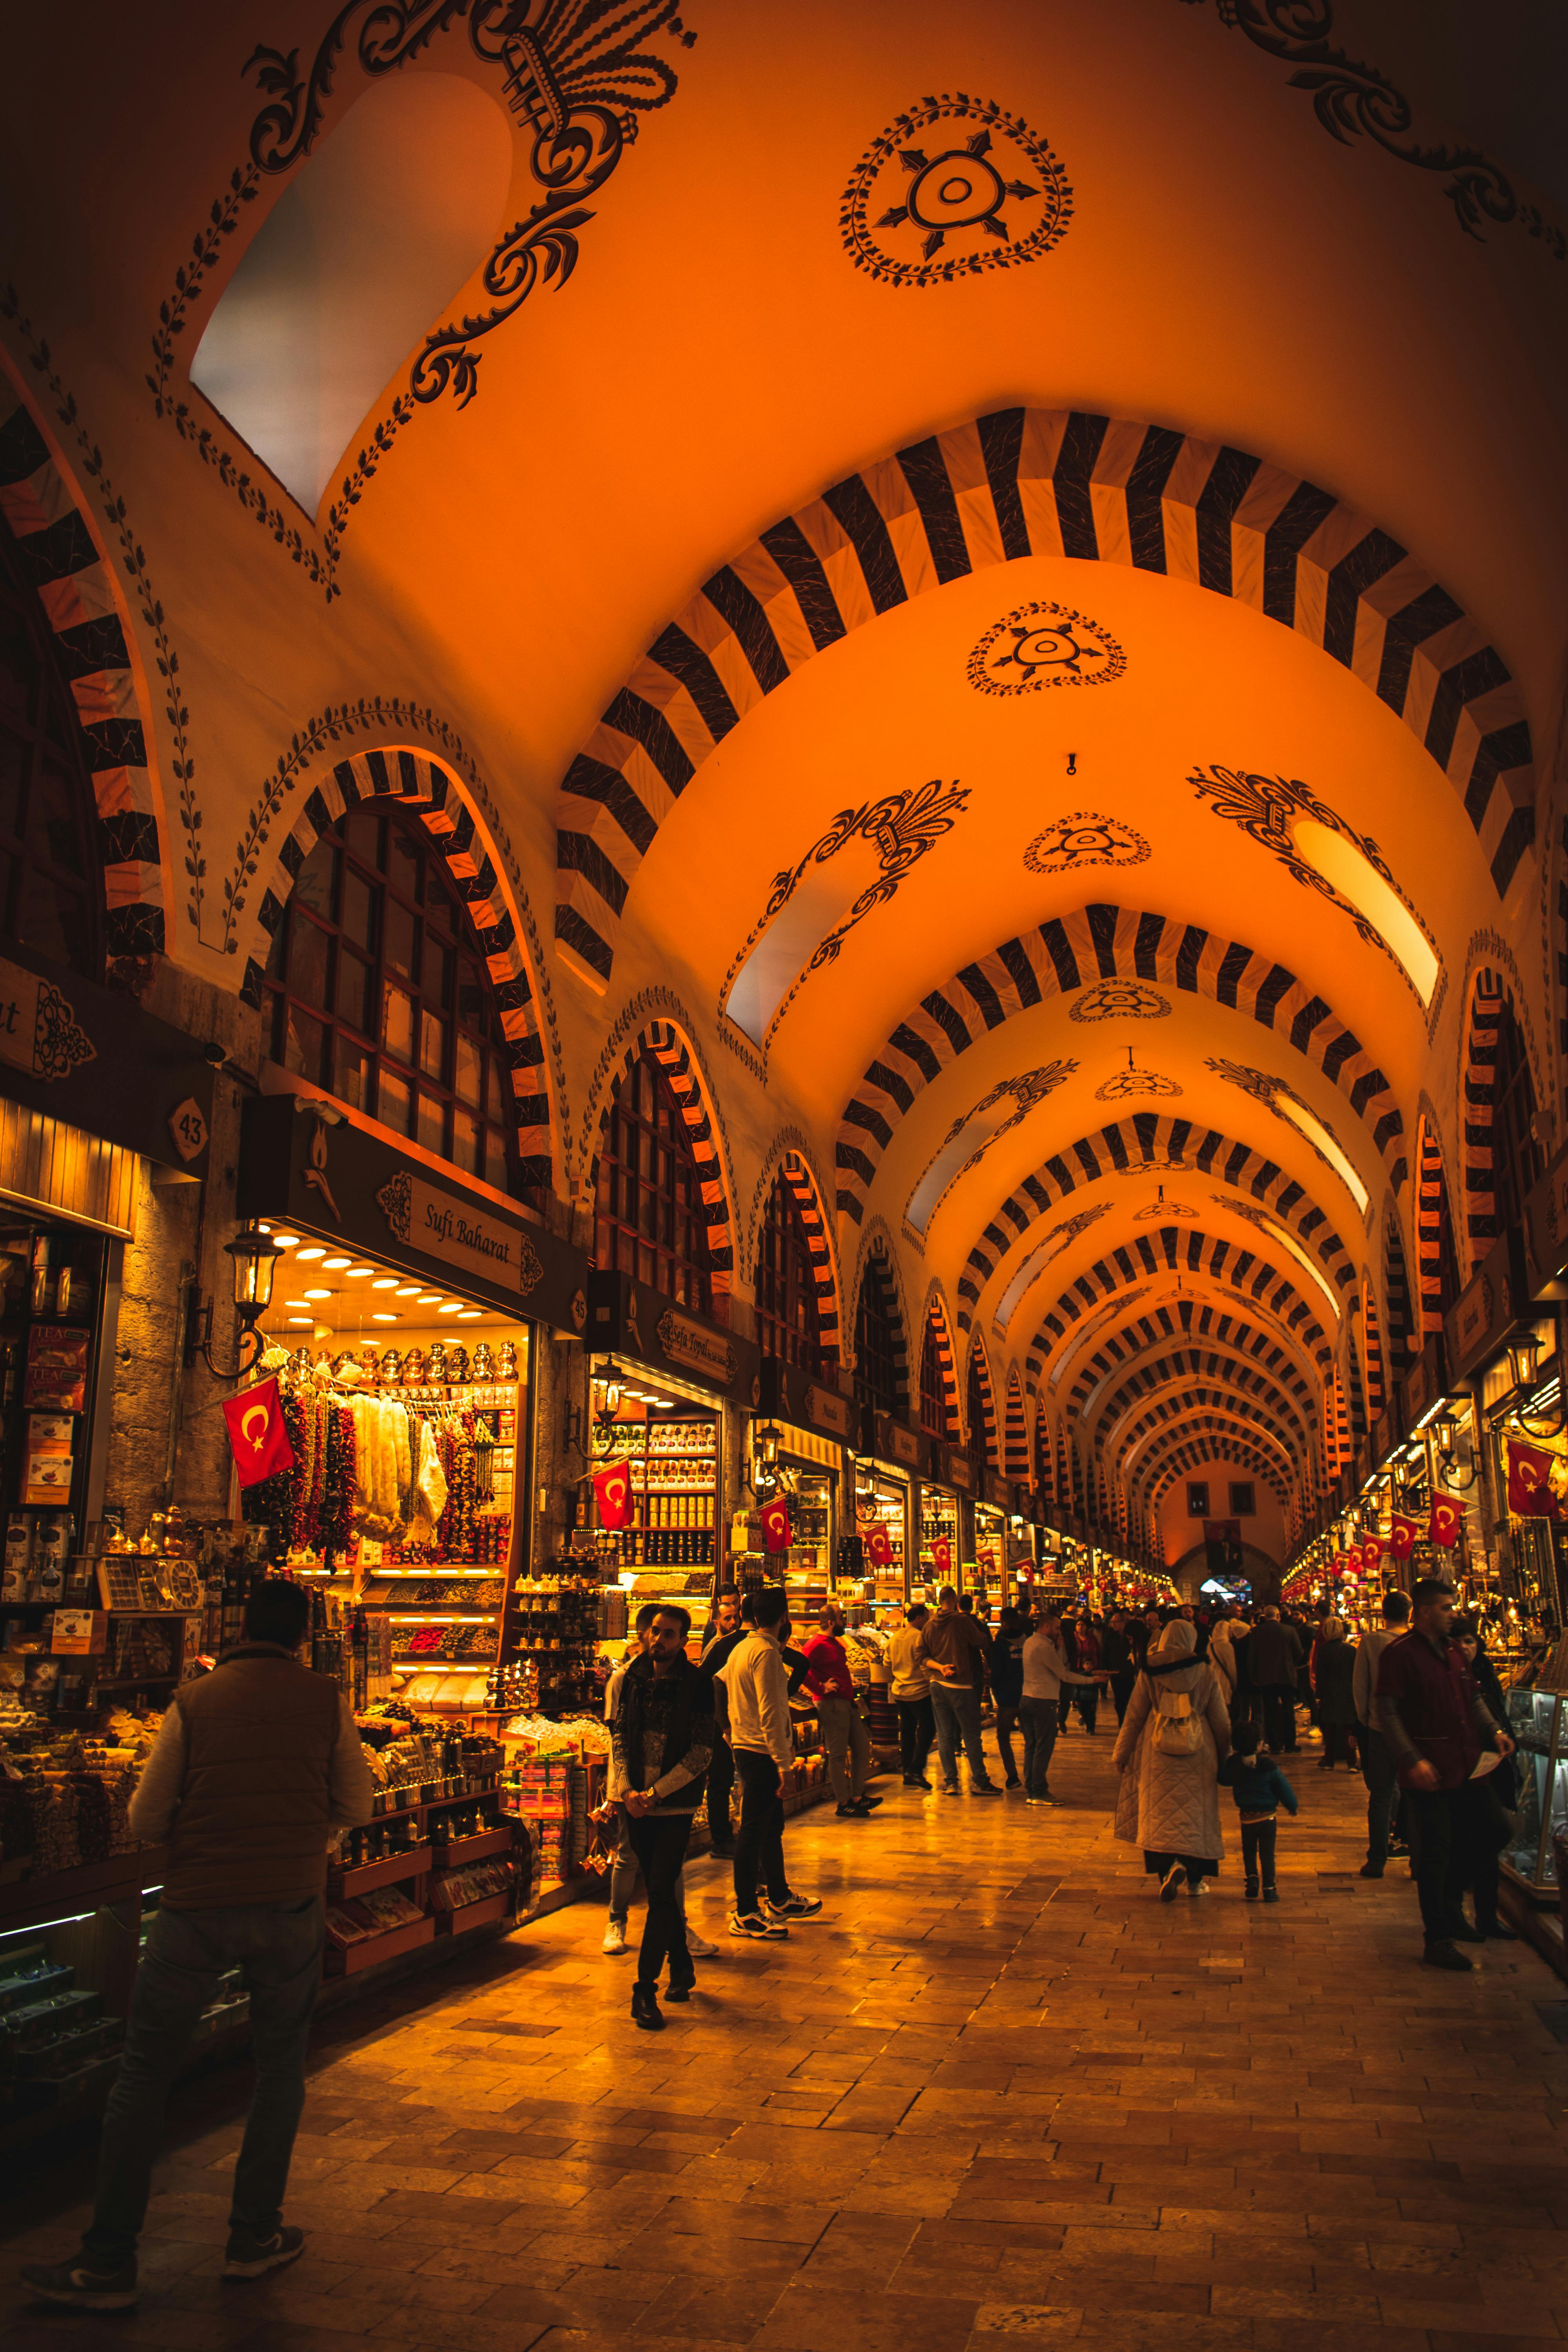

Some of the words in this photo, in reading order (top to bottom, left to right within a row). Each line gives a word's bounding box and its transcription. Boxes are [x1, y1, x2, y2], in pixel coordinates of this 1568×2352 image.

[179, 1114, 201, 1145] 43
[425, 1204, 453, 1242] Sufi
[456, 1220, 510, 1263] Baharat
[575, 1301, 584, 1318] 45
[36, 1326, 63, 1339] TEA
[672, 1325, 687, 1350] Sefa
[690, 1332, 709, 1358] Topal
[32, 1368, 59, 1380] TEA
